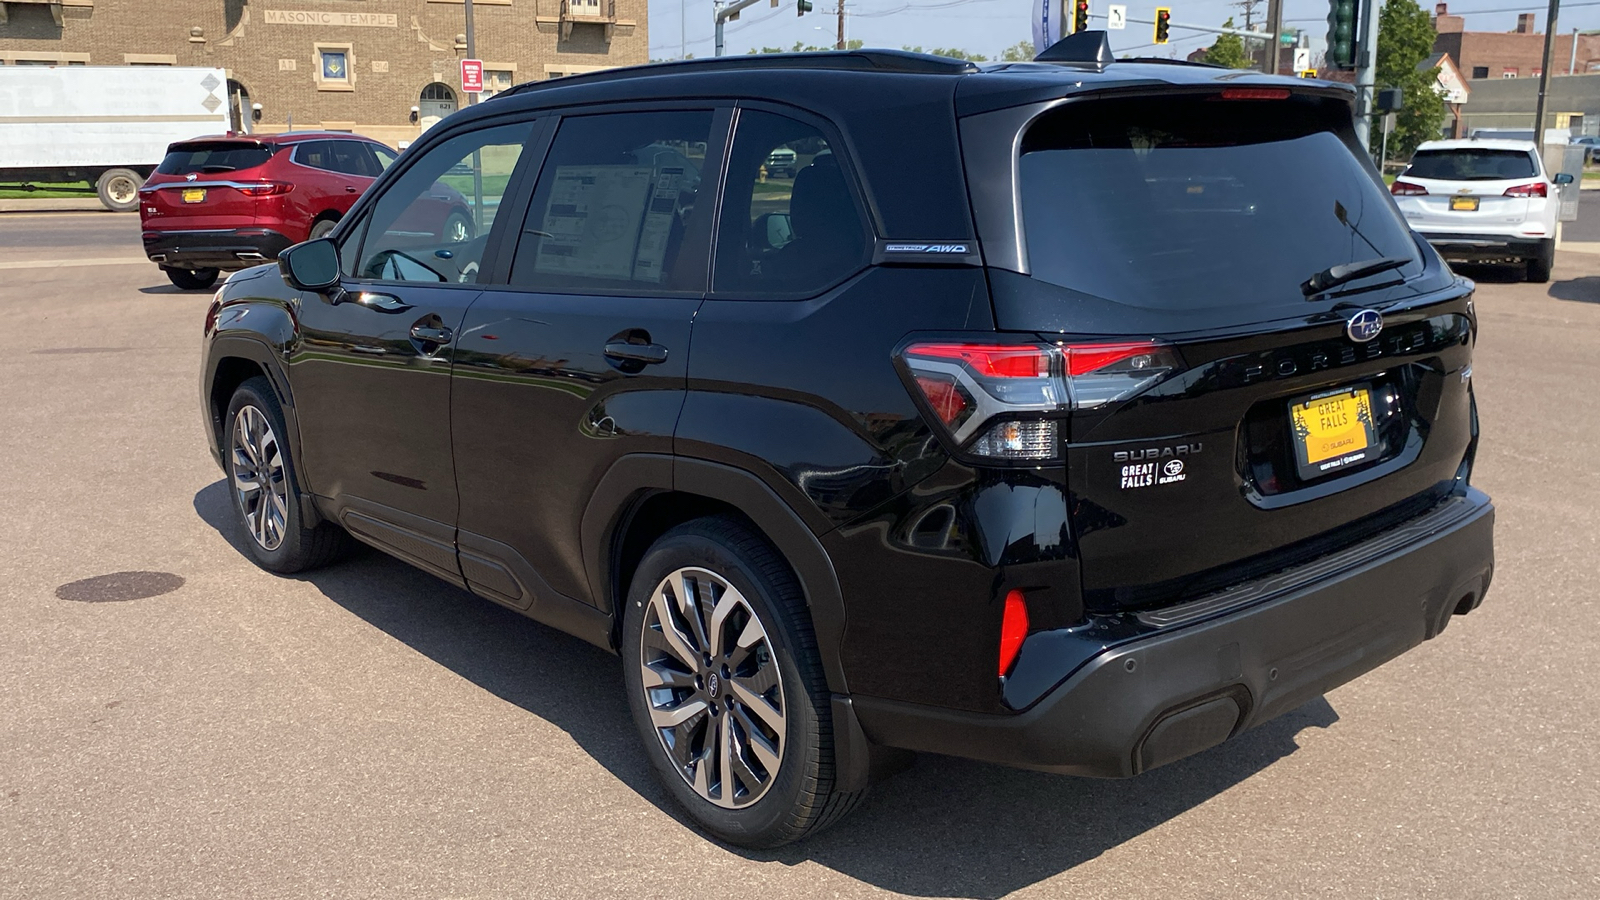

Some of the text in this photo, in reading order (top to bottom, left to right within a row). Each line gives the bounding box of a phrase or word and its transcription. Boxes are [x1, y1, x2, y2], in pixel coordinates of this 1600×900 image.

[267, 11, 396, 26] MASONIC TEMPLE
[926, 244, 967, 253] AWD
[1318, 399, 1345, 416] GREAT
[1320, 412, 1348, 431] FALLS
[1330, 438, 1354, 450] SUBARU
[1113, 442, 1203, 463] SUBARU
[1121, 463, 1154, 477] GREAT
[1121, 475, 1153, 489] FALLS
[1159, 474, 1186, 485] SUBARU
